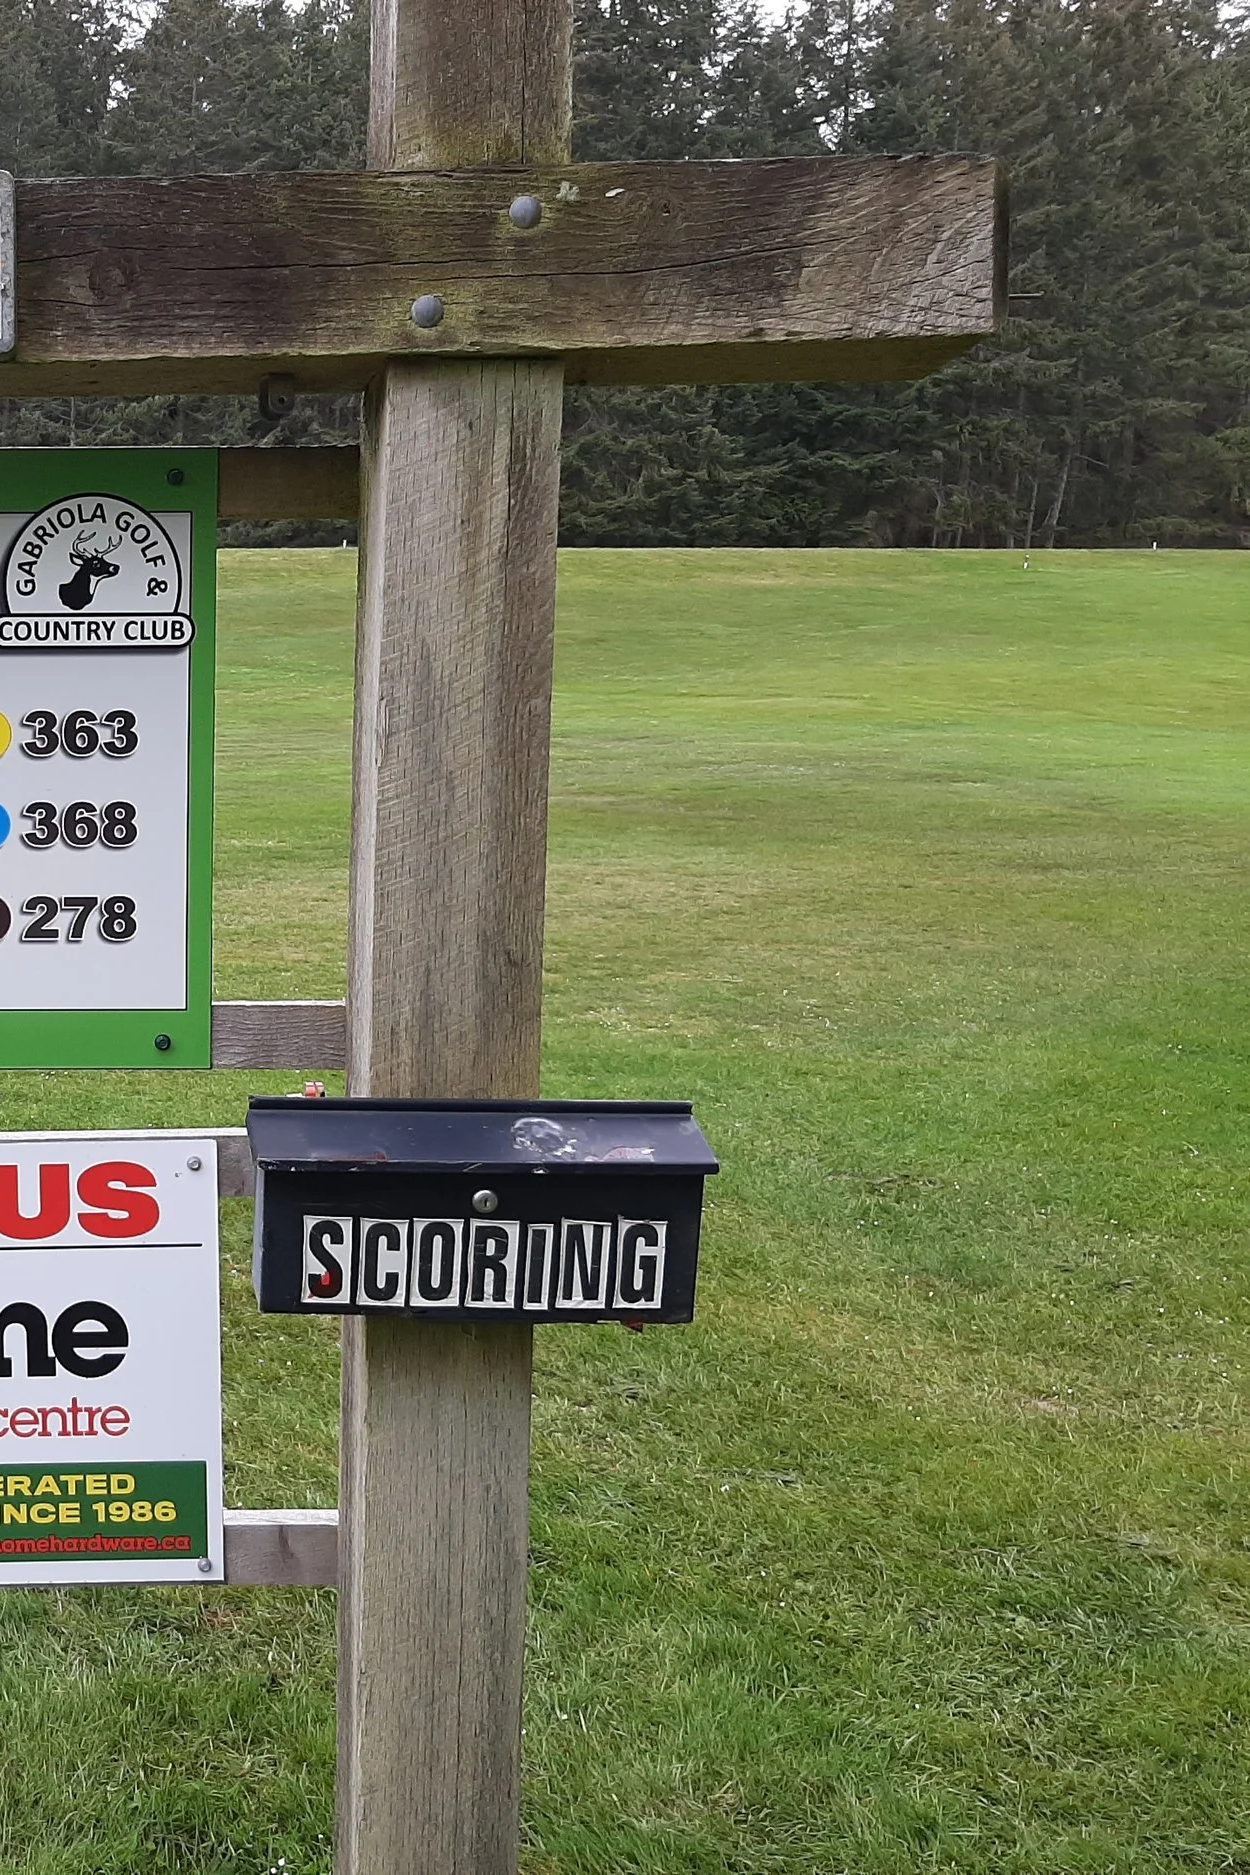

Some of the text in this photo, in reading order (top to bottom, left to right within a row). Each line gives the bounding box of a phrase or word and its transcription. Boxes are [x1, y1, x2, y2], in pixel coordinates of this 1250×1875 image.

[16, 503, 168, 597] GABRIOLA GOLF &
[123, 620, 186, 641] CLUB
[21, 710, 139, 757] 363
[21, 800, 138, 849] 368
[21, 896, 138, 942] 278
[306, 1220, 658, 1304] SCORING
[91, 1500, 177, 1523] 1986
